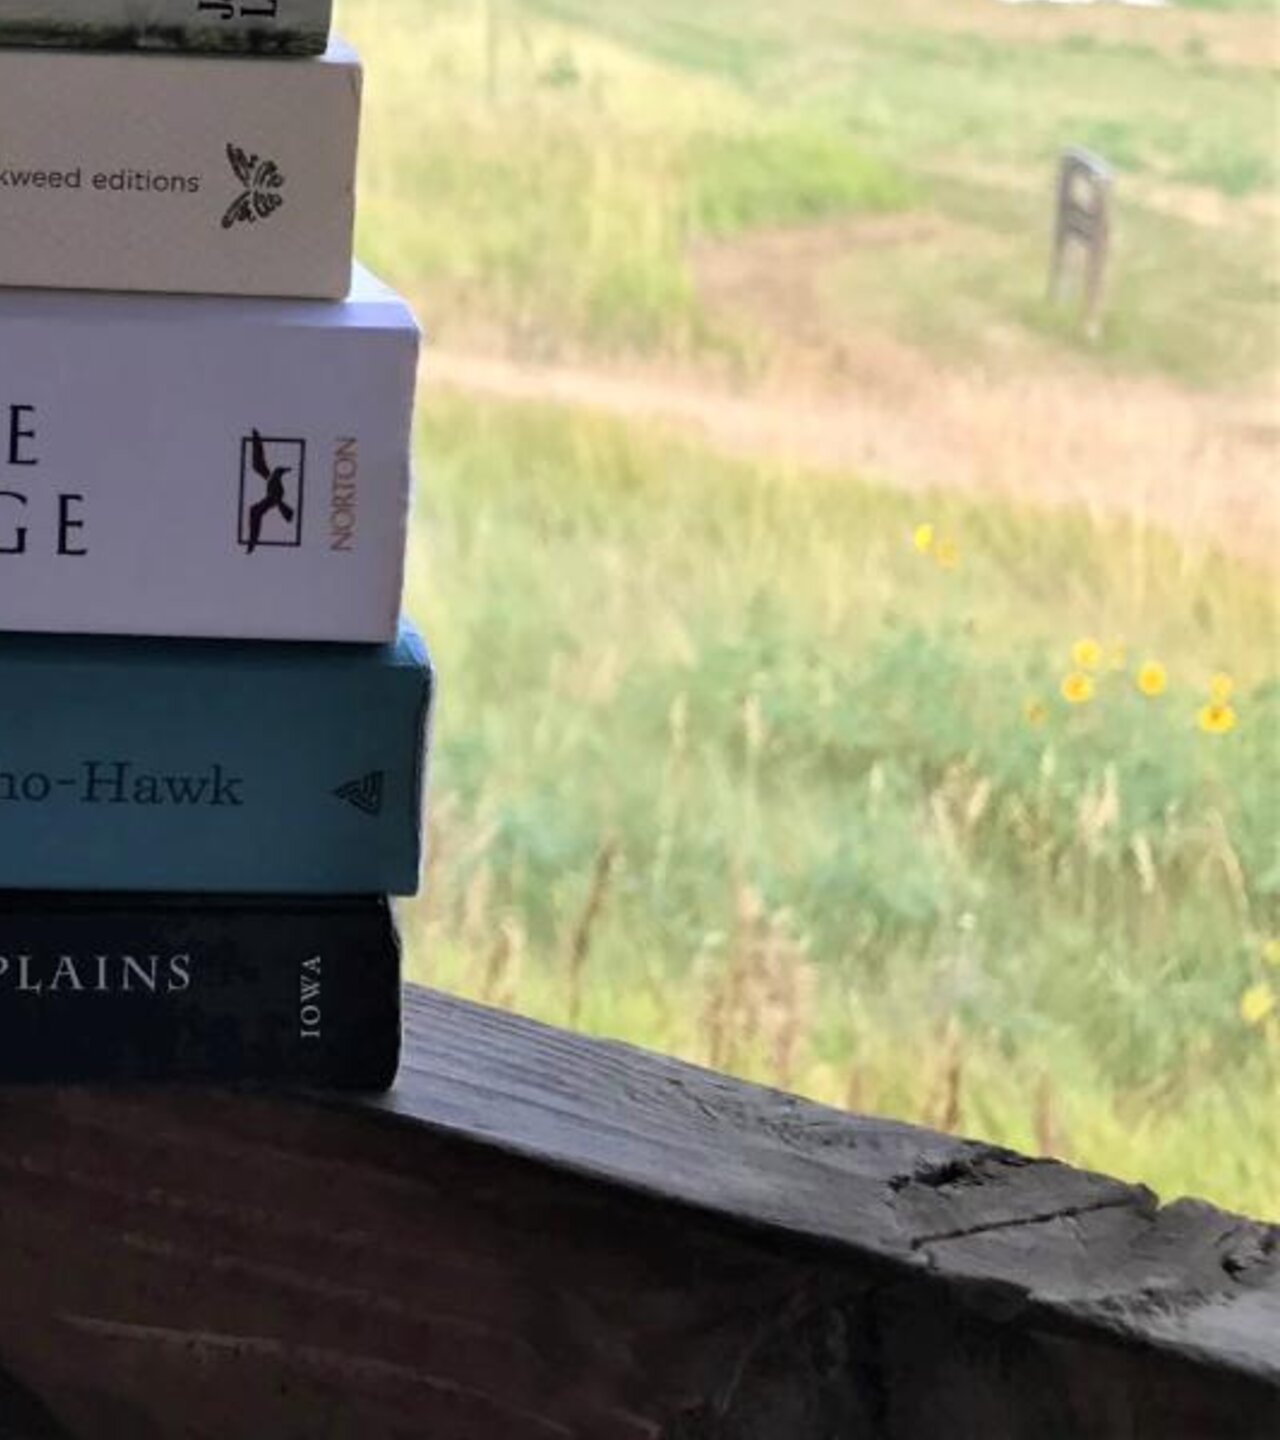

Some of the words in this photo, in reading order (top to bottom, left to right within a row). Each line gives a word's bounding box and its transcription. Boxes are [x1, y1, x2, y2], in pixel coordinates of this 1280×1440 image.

[93, 167, 200, 193] editions
[330, 437, 357, 550] NORTON
[301, 955, 322, 1038] IOWA
